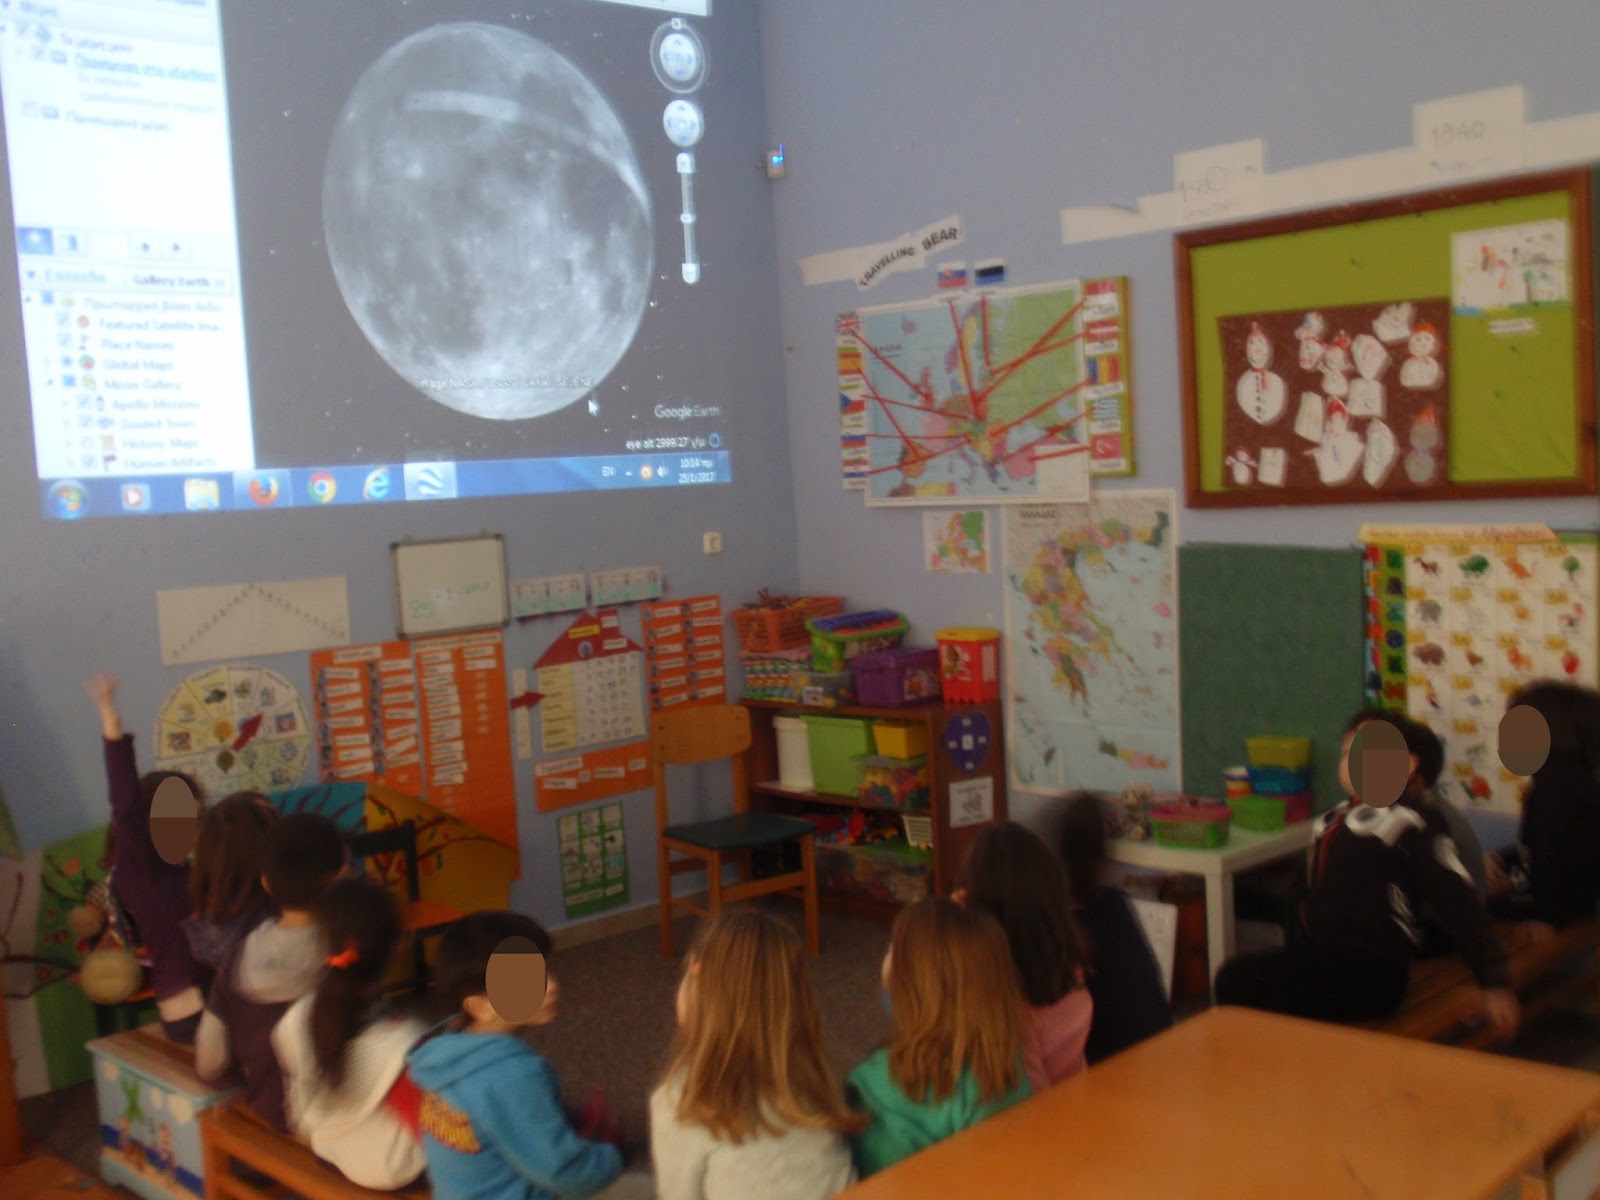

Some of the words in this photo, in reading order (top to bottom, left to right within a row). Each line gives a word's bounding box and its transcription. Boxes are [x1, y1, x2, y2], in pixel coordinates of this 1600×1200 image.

[859, 246, 916, 286] TRAVELLING
[922, 227, 958, 251] BEAR
[654, 404, 692, 421] Google
[693, 404, 720, 417] Earth
[625, 440, 642, 451] eye
[643, 438, 655, 449] alt
